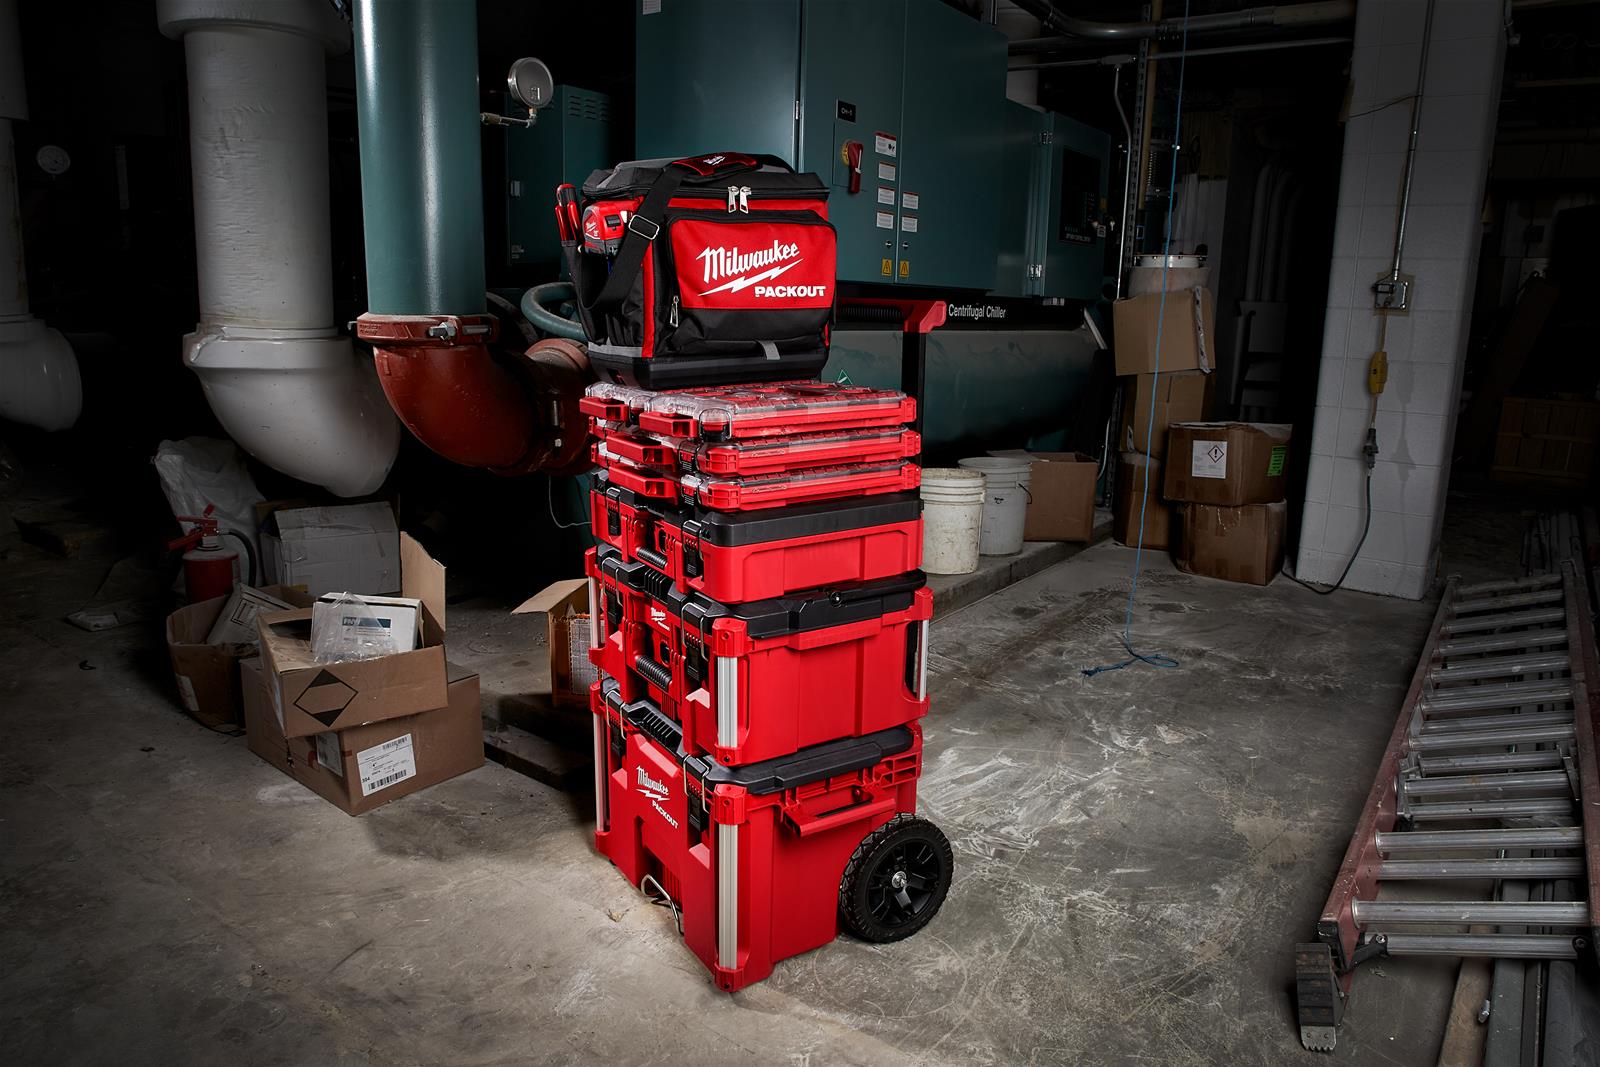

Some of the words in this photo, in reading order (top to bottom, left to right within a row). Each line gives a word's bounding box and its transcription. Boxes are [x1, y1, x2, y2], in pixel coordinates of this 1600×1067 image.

[696, 239, 800, 284] Milwaukee
[754, 285, 827, 298] PACKOUT
[948, 303, 985, 320] Centrifugal
[986, 305, 1007, 319] Chiller
[636, 765, 669, 796] Milwaukee
[652, 799, 679, 829] PACKOUT
